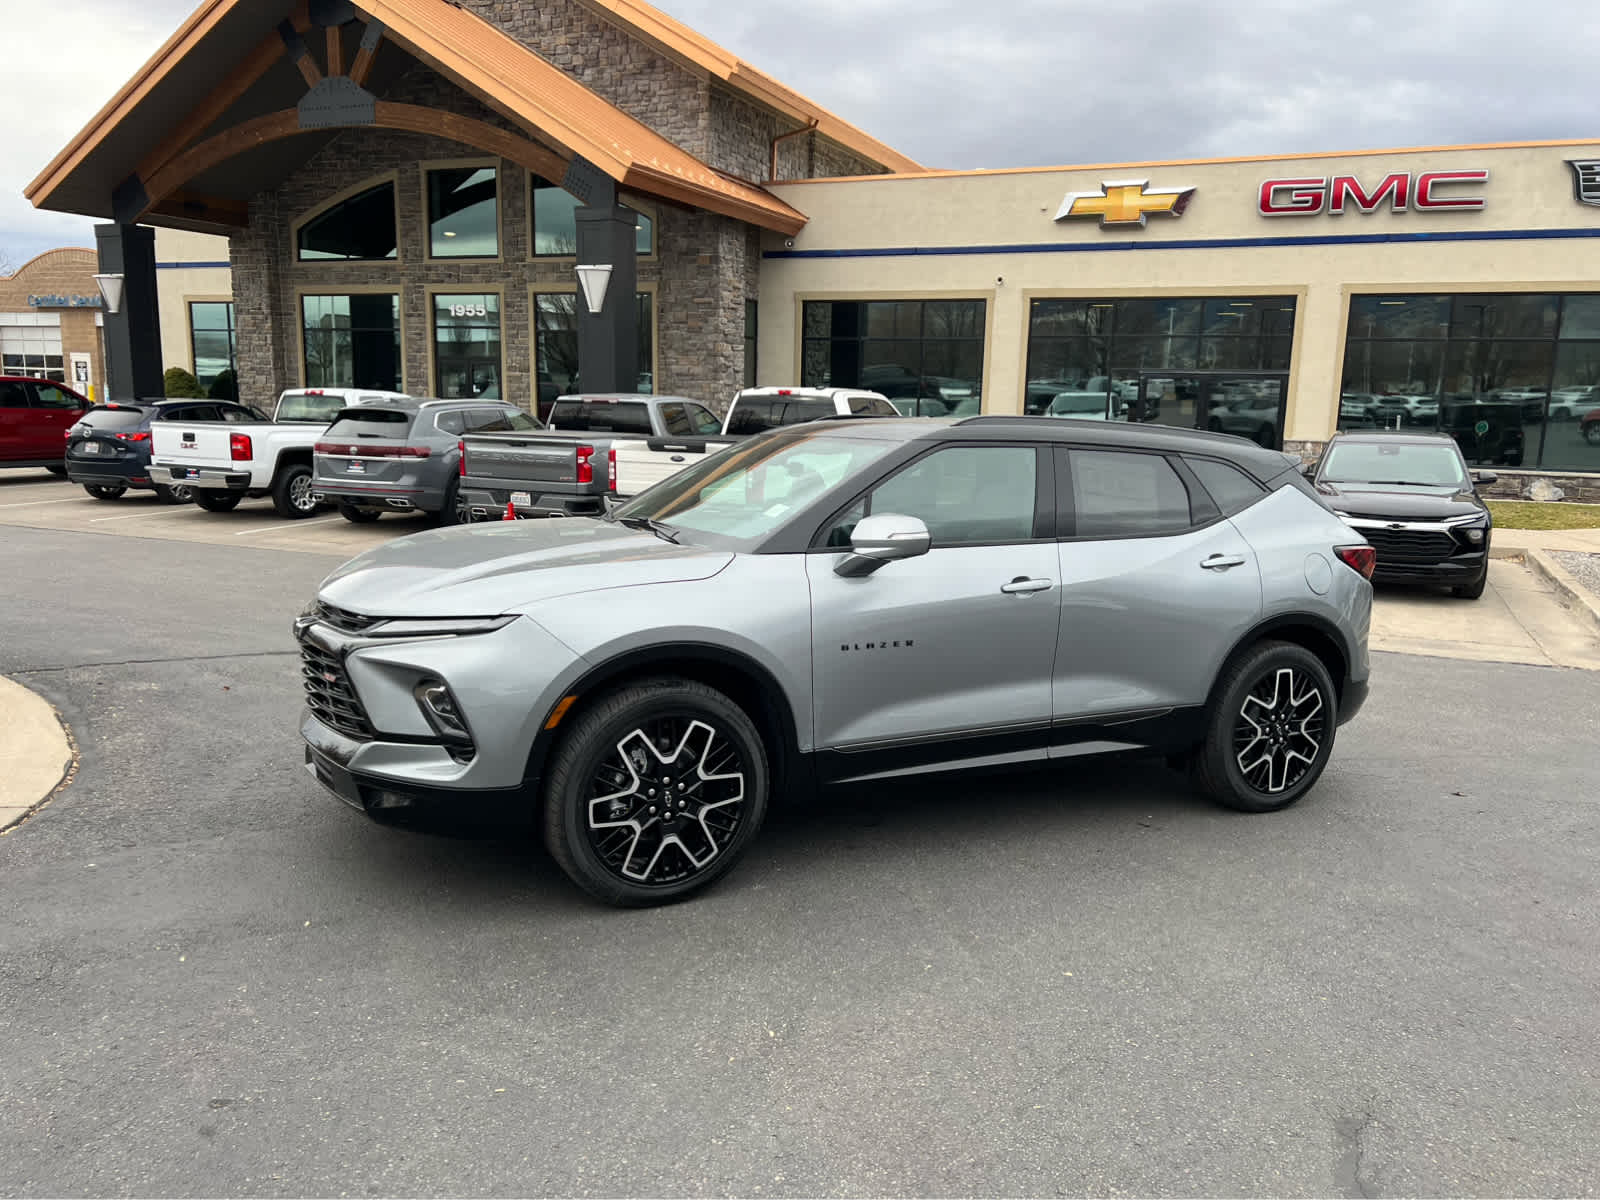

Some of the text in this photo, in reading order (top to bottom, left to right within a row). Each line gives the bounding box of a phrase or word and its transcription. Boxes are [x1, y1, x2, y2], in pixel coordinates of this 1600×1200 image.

[1258, 169, 1489, 216] GMC
[448, 303, 486, 317] 1955
[841, 640, 914, 651] BLAZER
